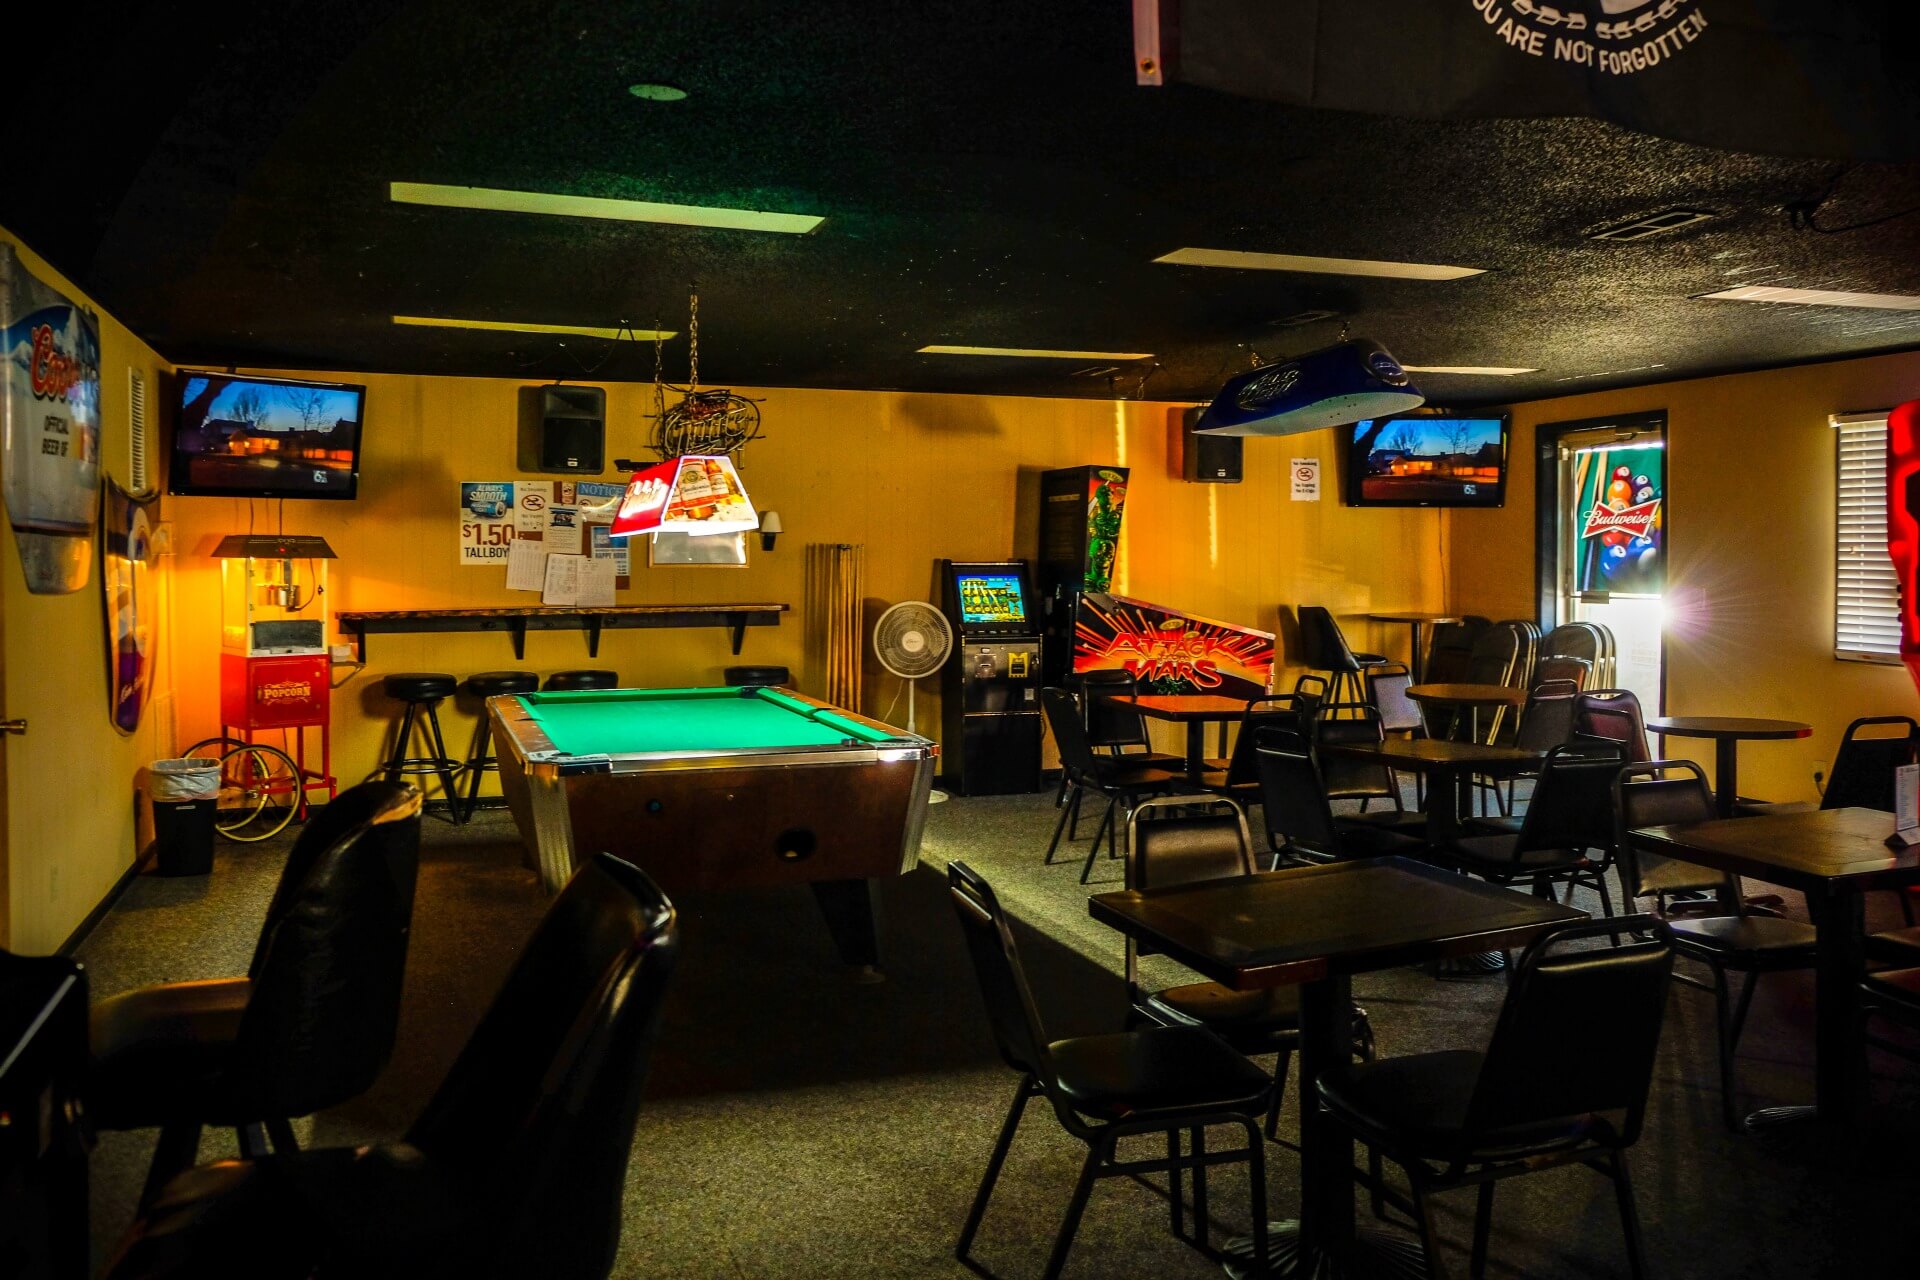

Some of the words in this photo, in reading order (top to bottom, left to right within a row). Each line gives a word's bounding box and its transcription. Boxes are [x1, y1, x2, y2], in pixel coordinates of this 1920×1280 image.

[1472, 0, 1502, 25] OU
[1496, 18, 1547, 56] ARE
[1554, 37, 1594, 67] NOT
[1599, 8, 1708, 75] FORGOTTEN
[44, 415, 69, 435] OFFICIAL
[42, 438, 59, 455] BEER
[469, 491, 508, 501] SMOOTH
[476, 484, 504, 492] ALWAYS
[580, 484, 623, 497] NOTICE
[1583, 510, 1656, 527] Budweiser
[462, 523, 515, 546] $1.50
[1105, 632, 1244, 666] ATTACK
[1122, 659, 1223, 691] MARS
[264, 686, 311, 699] POPCORN
